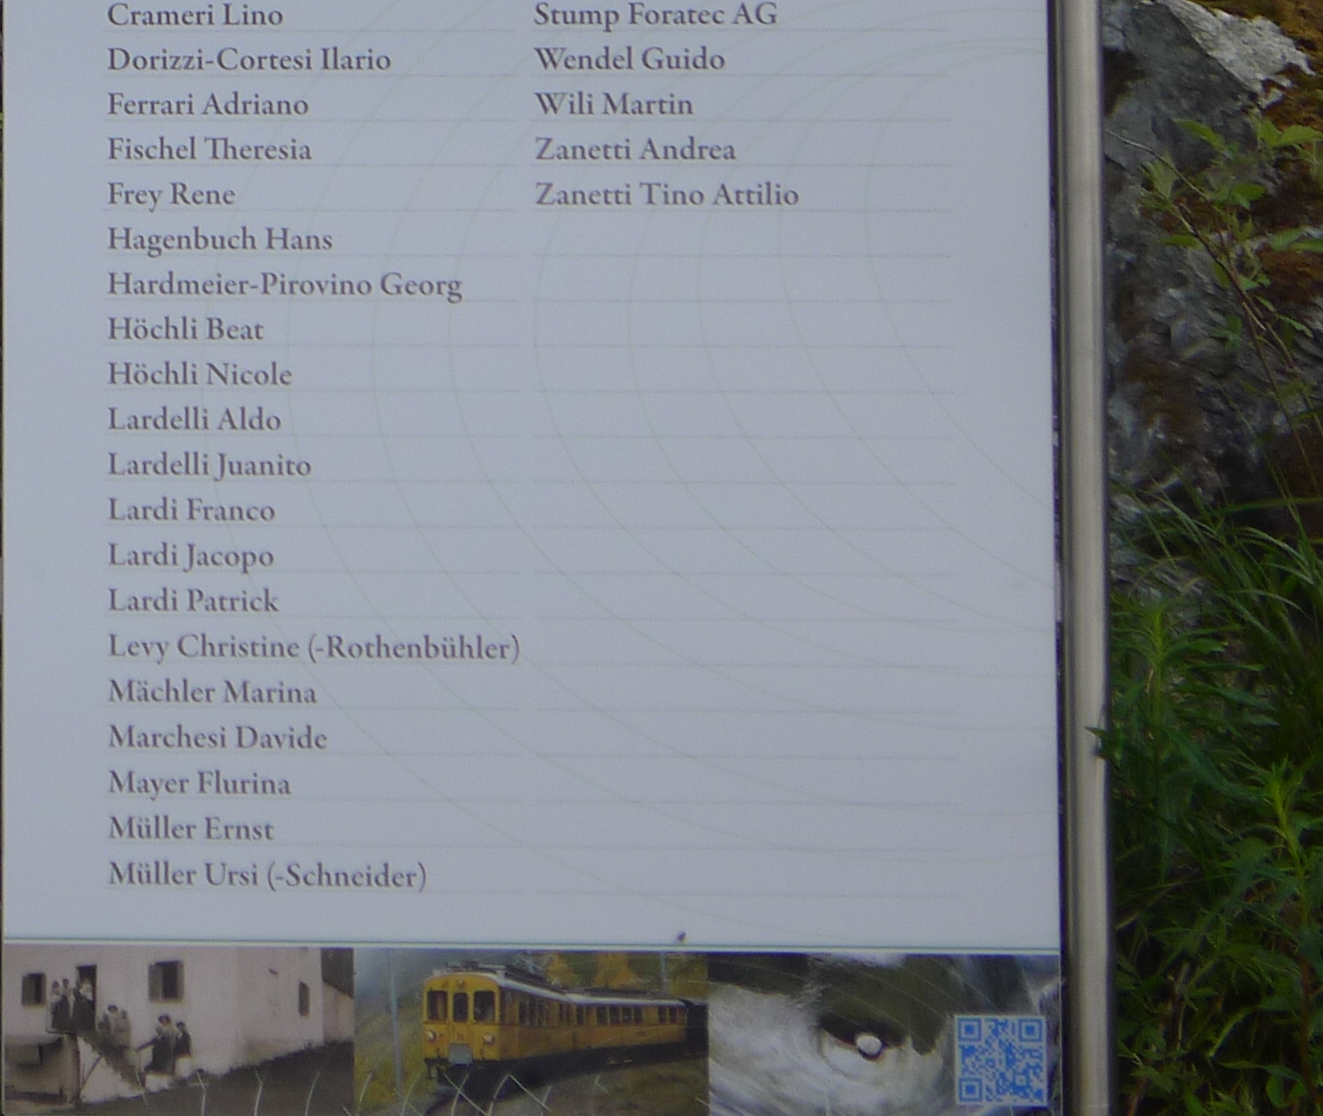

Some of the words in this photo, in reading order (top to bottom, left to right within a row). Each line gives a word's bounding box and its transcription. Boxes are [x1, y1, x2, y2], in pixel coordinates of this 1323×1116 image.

[535, 2, 619, 33] Stump
[629, 2, 724, 25] Foratec
[733, 2, 777, 25] AG
[108, 136, 196, 160] Fischel
[204, 137, 312, 160] Theresia
[537, 182, 632, 205] Zanetti
[640, 183, 704, 205] Tino
[713, 181, 799, 206] Attilio
[109, 271, 372, 295] Hardmeier-Pirovino
[380, 272, 462, 304] Georg
[109, 451, 209, 476] Lardelli
[213, 453, 311, 482] Juanito
[110, 634, 168, 664] Levy
[177, 633, 299, 658] Christine
[308, 634, 519, 663] (-Rothenbühler)
[110, 861, 196, 885] Müller
[205, 863, 258, 886] Ursi
[267, 862, 426, 892] (-Schneider)
